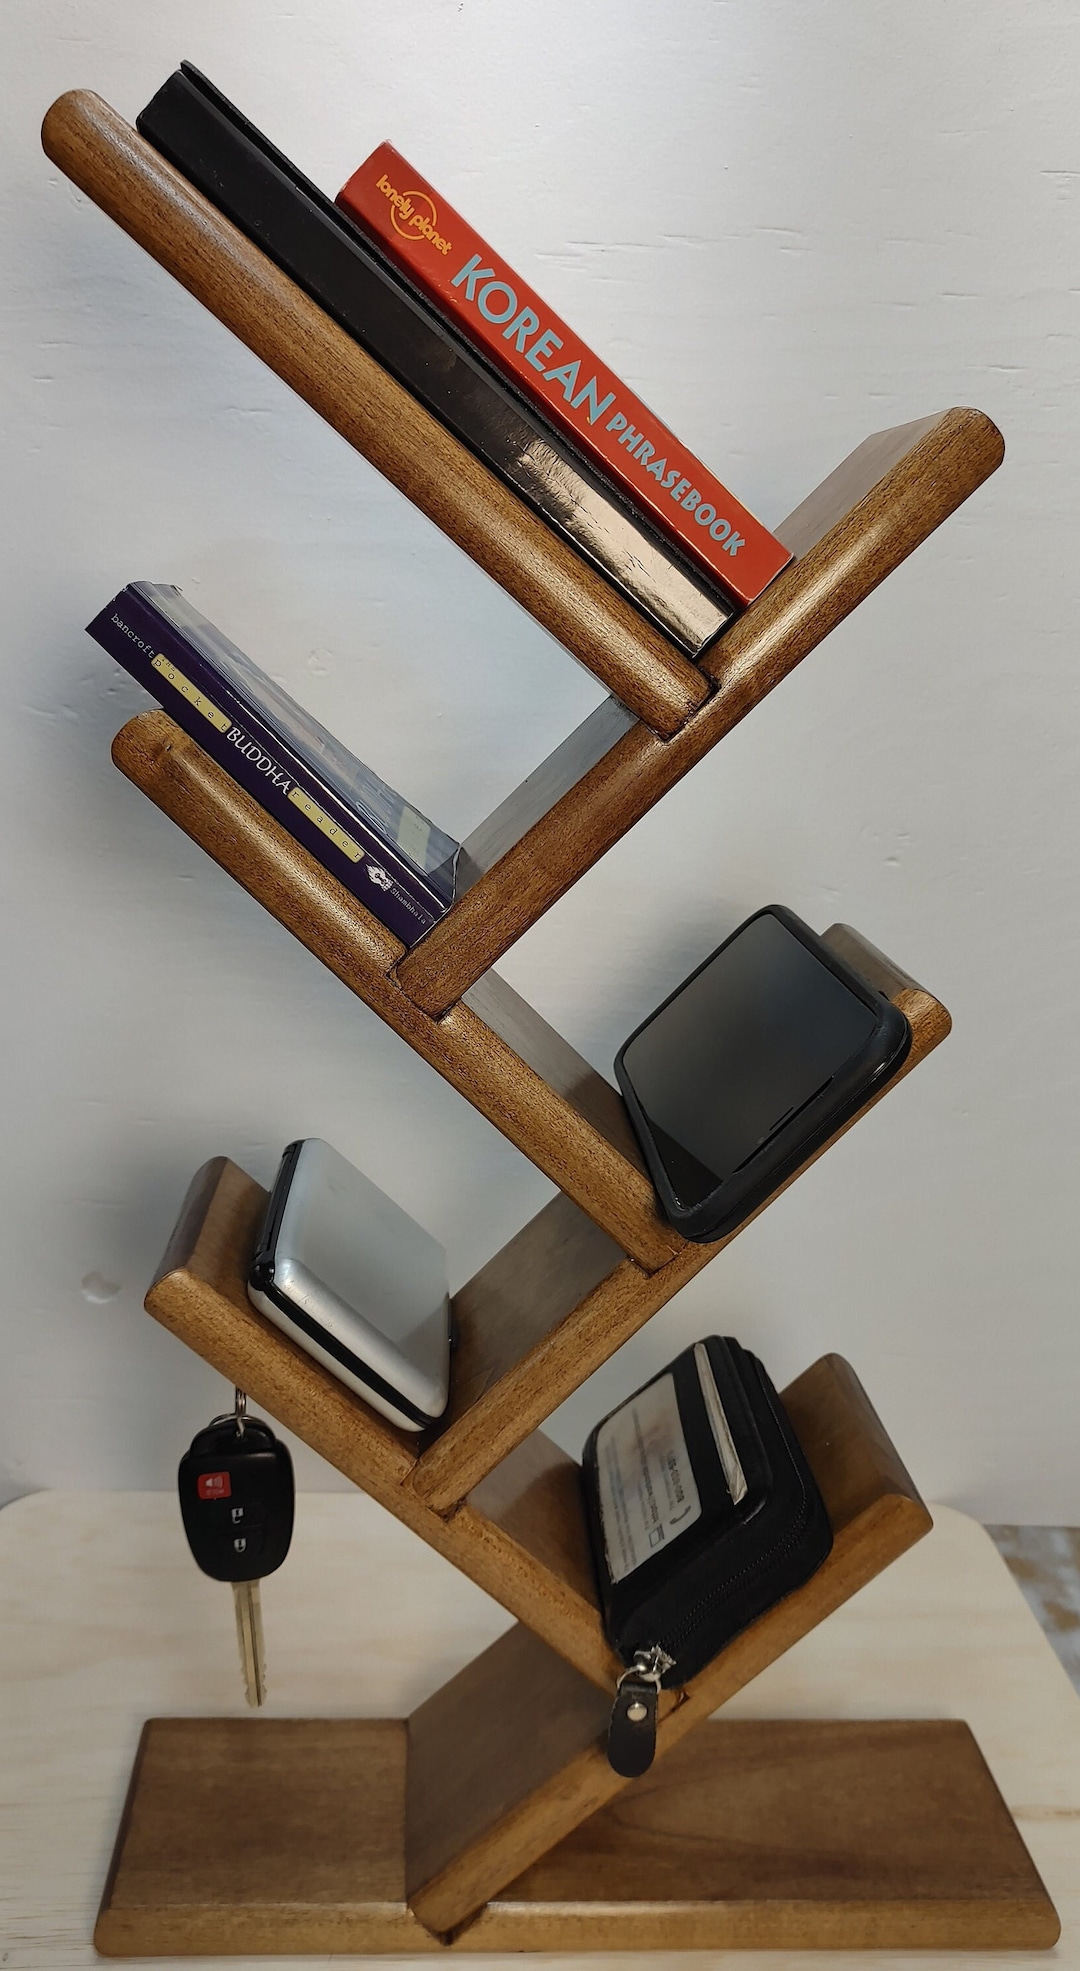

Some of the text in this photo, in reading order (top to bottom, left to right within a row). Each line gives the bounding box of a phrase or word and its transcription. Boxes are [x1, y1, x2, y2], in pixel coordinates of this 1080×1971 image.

[375, 174, 453, 256] lonely planet
[451, 254, 746, 557] KOREAN PHRASEBOOK
[111, 612, 156, 660] bancroft
[226, 726, 292, 796] BUDDHA
[290, 789, 363, 860] reader
[389, 887, 428, 926] Shambhala
